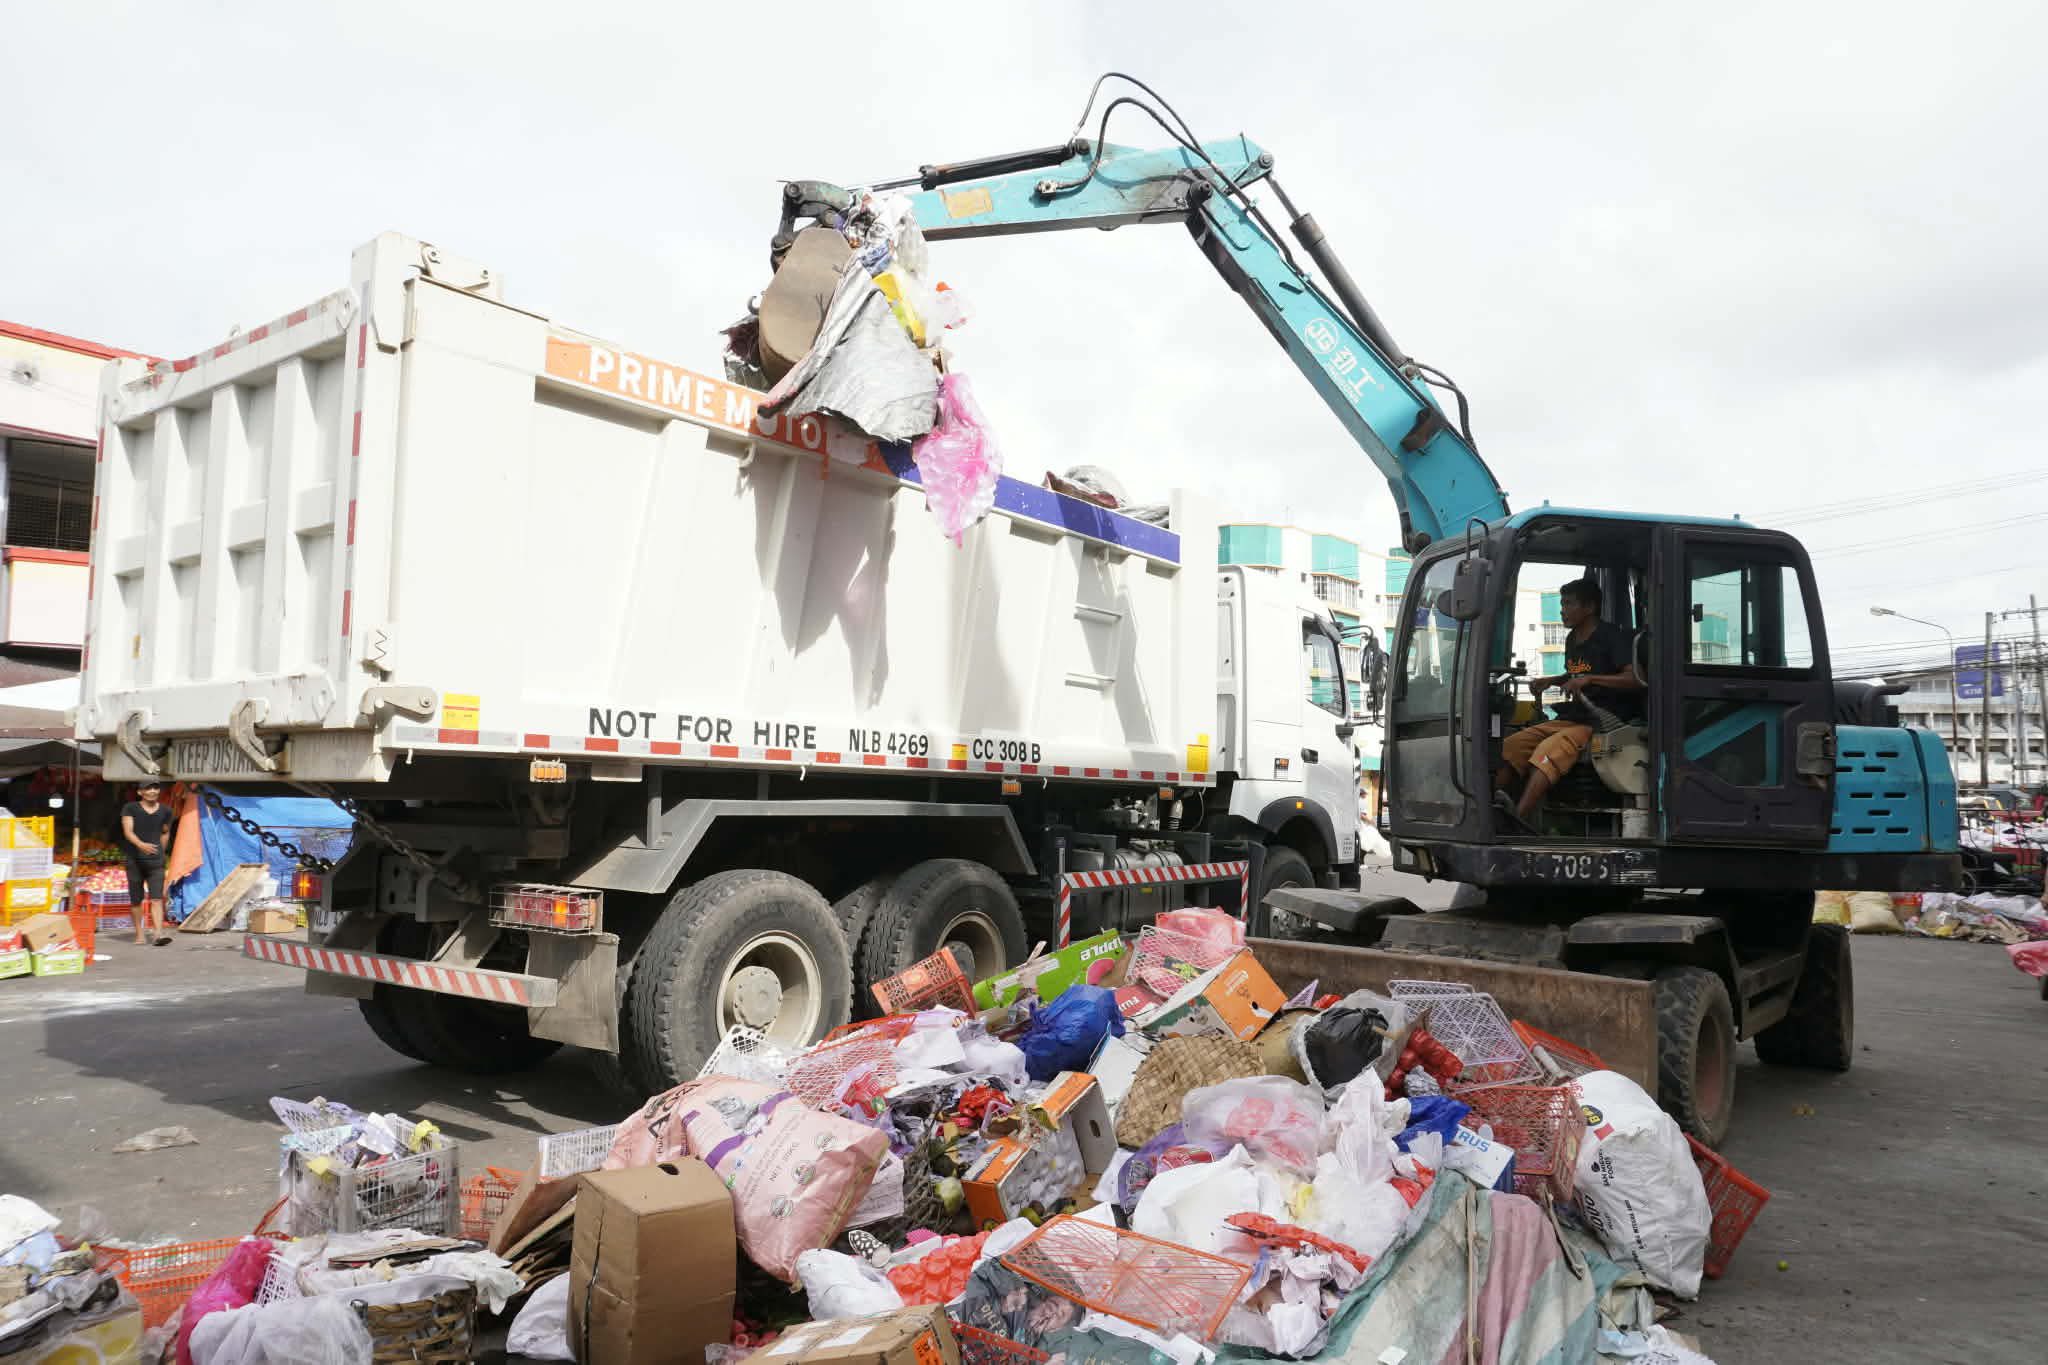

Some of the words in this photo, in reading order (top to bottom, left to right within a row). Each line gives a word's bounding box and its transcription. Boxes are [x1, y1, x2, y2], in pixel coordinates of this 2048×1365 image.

[588, 346, 715, 417] PRIME
[589, 708, 656, 739] NOT
[677, 714, 733, 743] FOR
[754, 721, 817, 750] HIRE
[849, 729, 881, 753] NLB
[887, 732, 929, 756] 4269
[176, 742, 209, 773] KEEP
[973, 738, 994, 760] CC
[1000, 740, 1027, 762] 308
[1031, 743, 1041, 763] B
